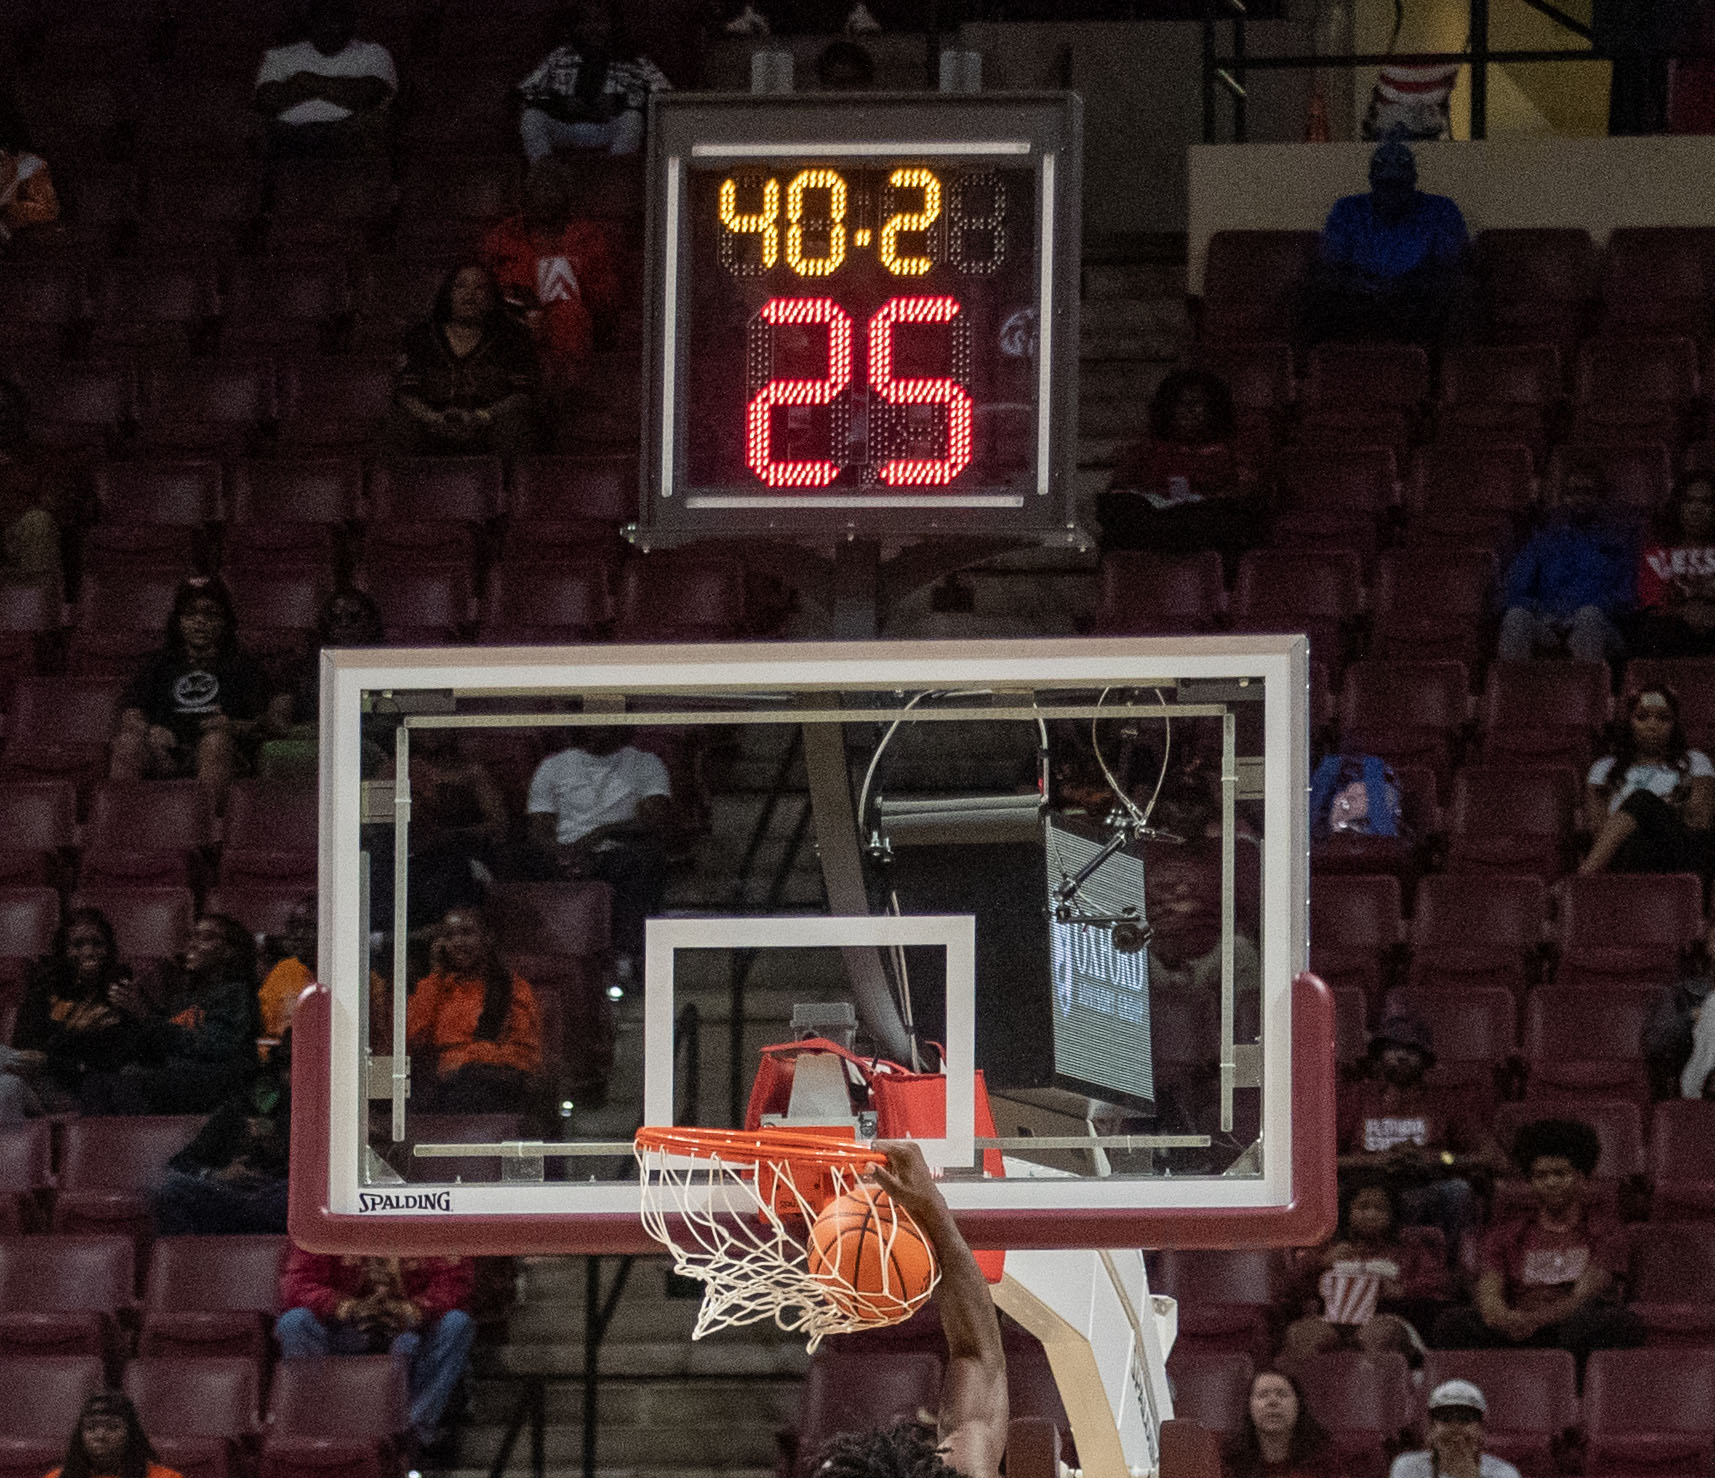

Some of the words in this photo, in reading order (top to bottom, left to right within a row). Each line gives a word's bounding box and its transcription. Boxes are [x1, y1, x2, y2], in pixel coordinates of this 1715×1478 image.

[719, 167, 941, 276] 40.2
[746, 297, 972, 487] 25
[359, 1191, 451, 1213] SPALDING
